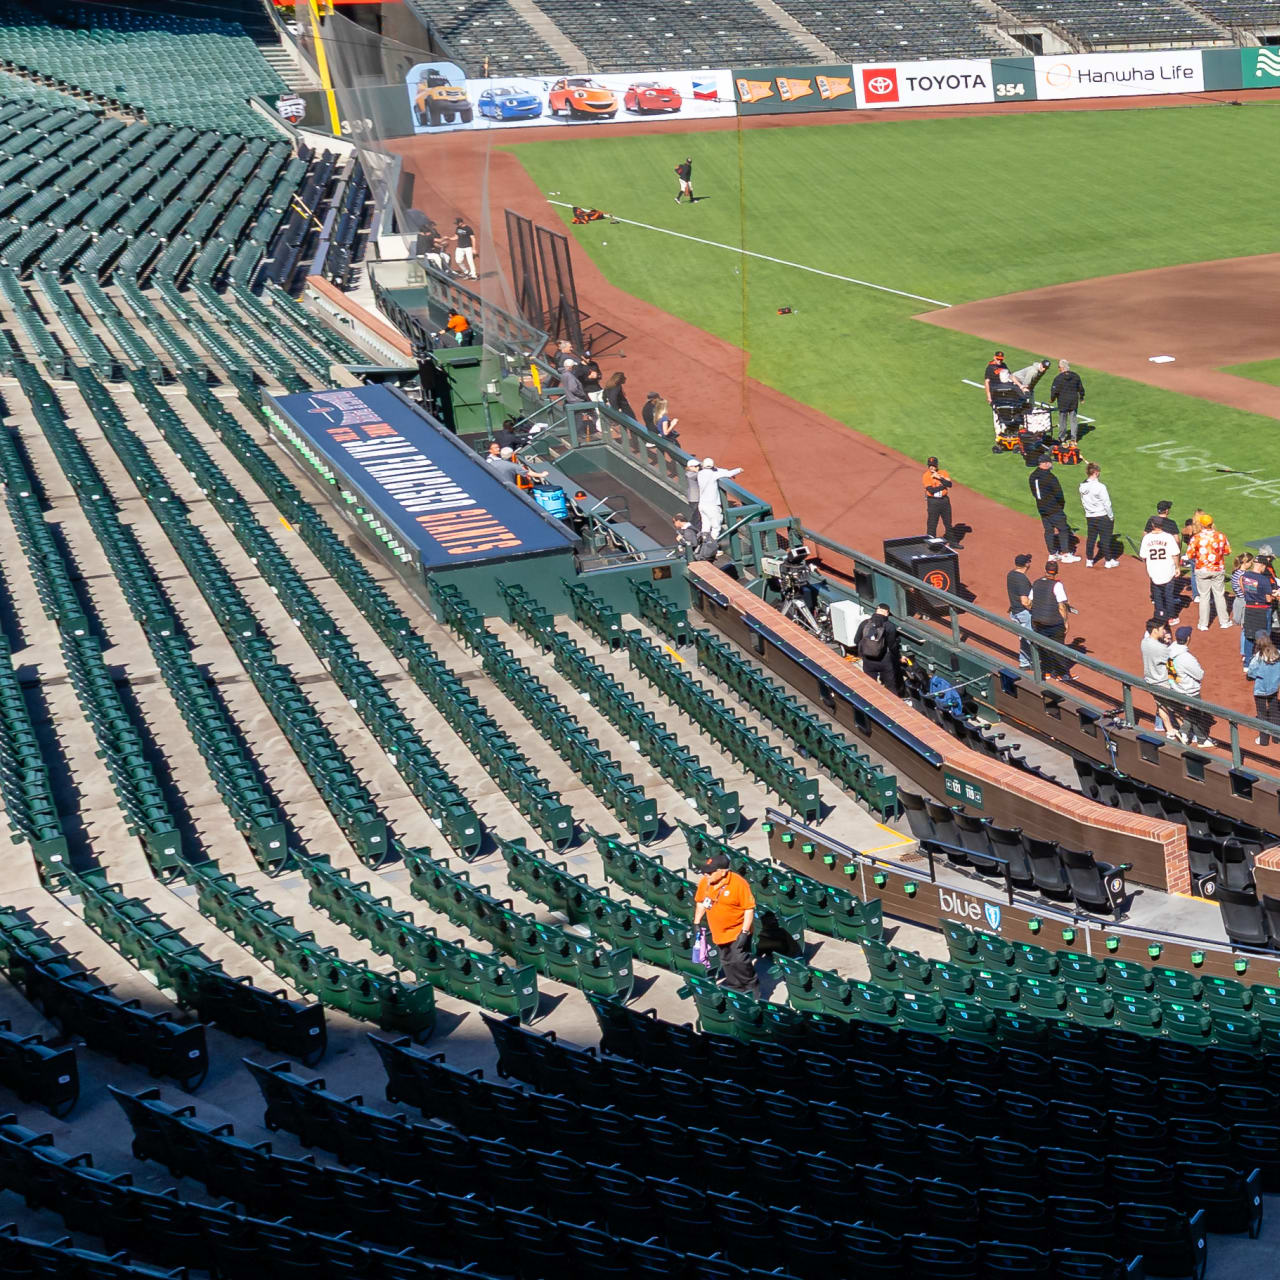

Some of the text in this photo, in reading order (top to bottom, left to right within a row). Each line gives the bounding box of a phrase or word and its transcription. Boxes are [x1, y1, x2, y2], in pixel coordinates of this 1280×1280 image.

[906, 73, 987, 92] TOYOTA
[1078, 65, 1194, 84] Hanwha Life
[996, 83, 1025, 97] 354
[415, 508, 523, 555] GIANTS
[1149, 549, 1166, 560] 22
[938, 888, 982, 921] blue
